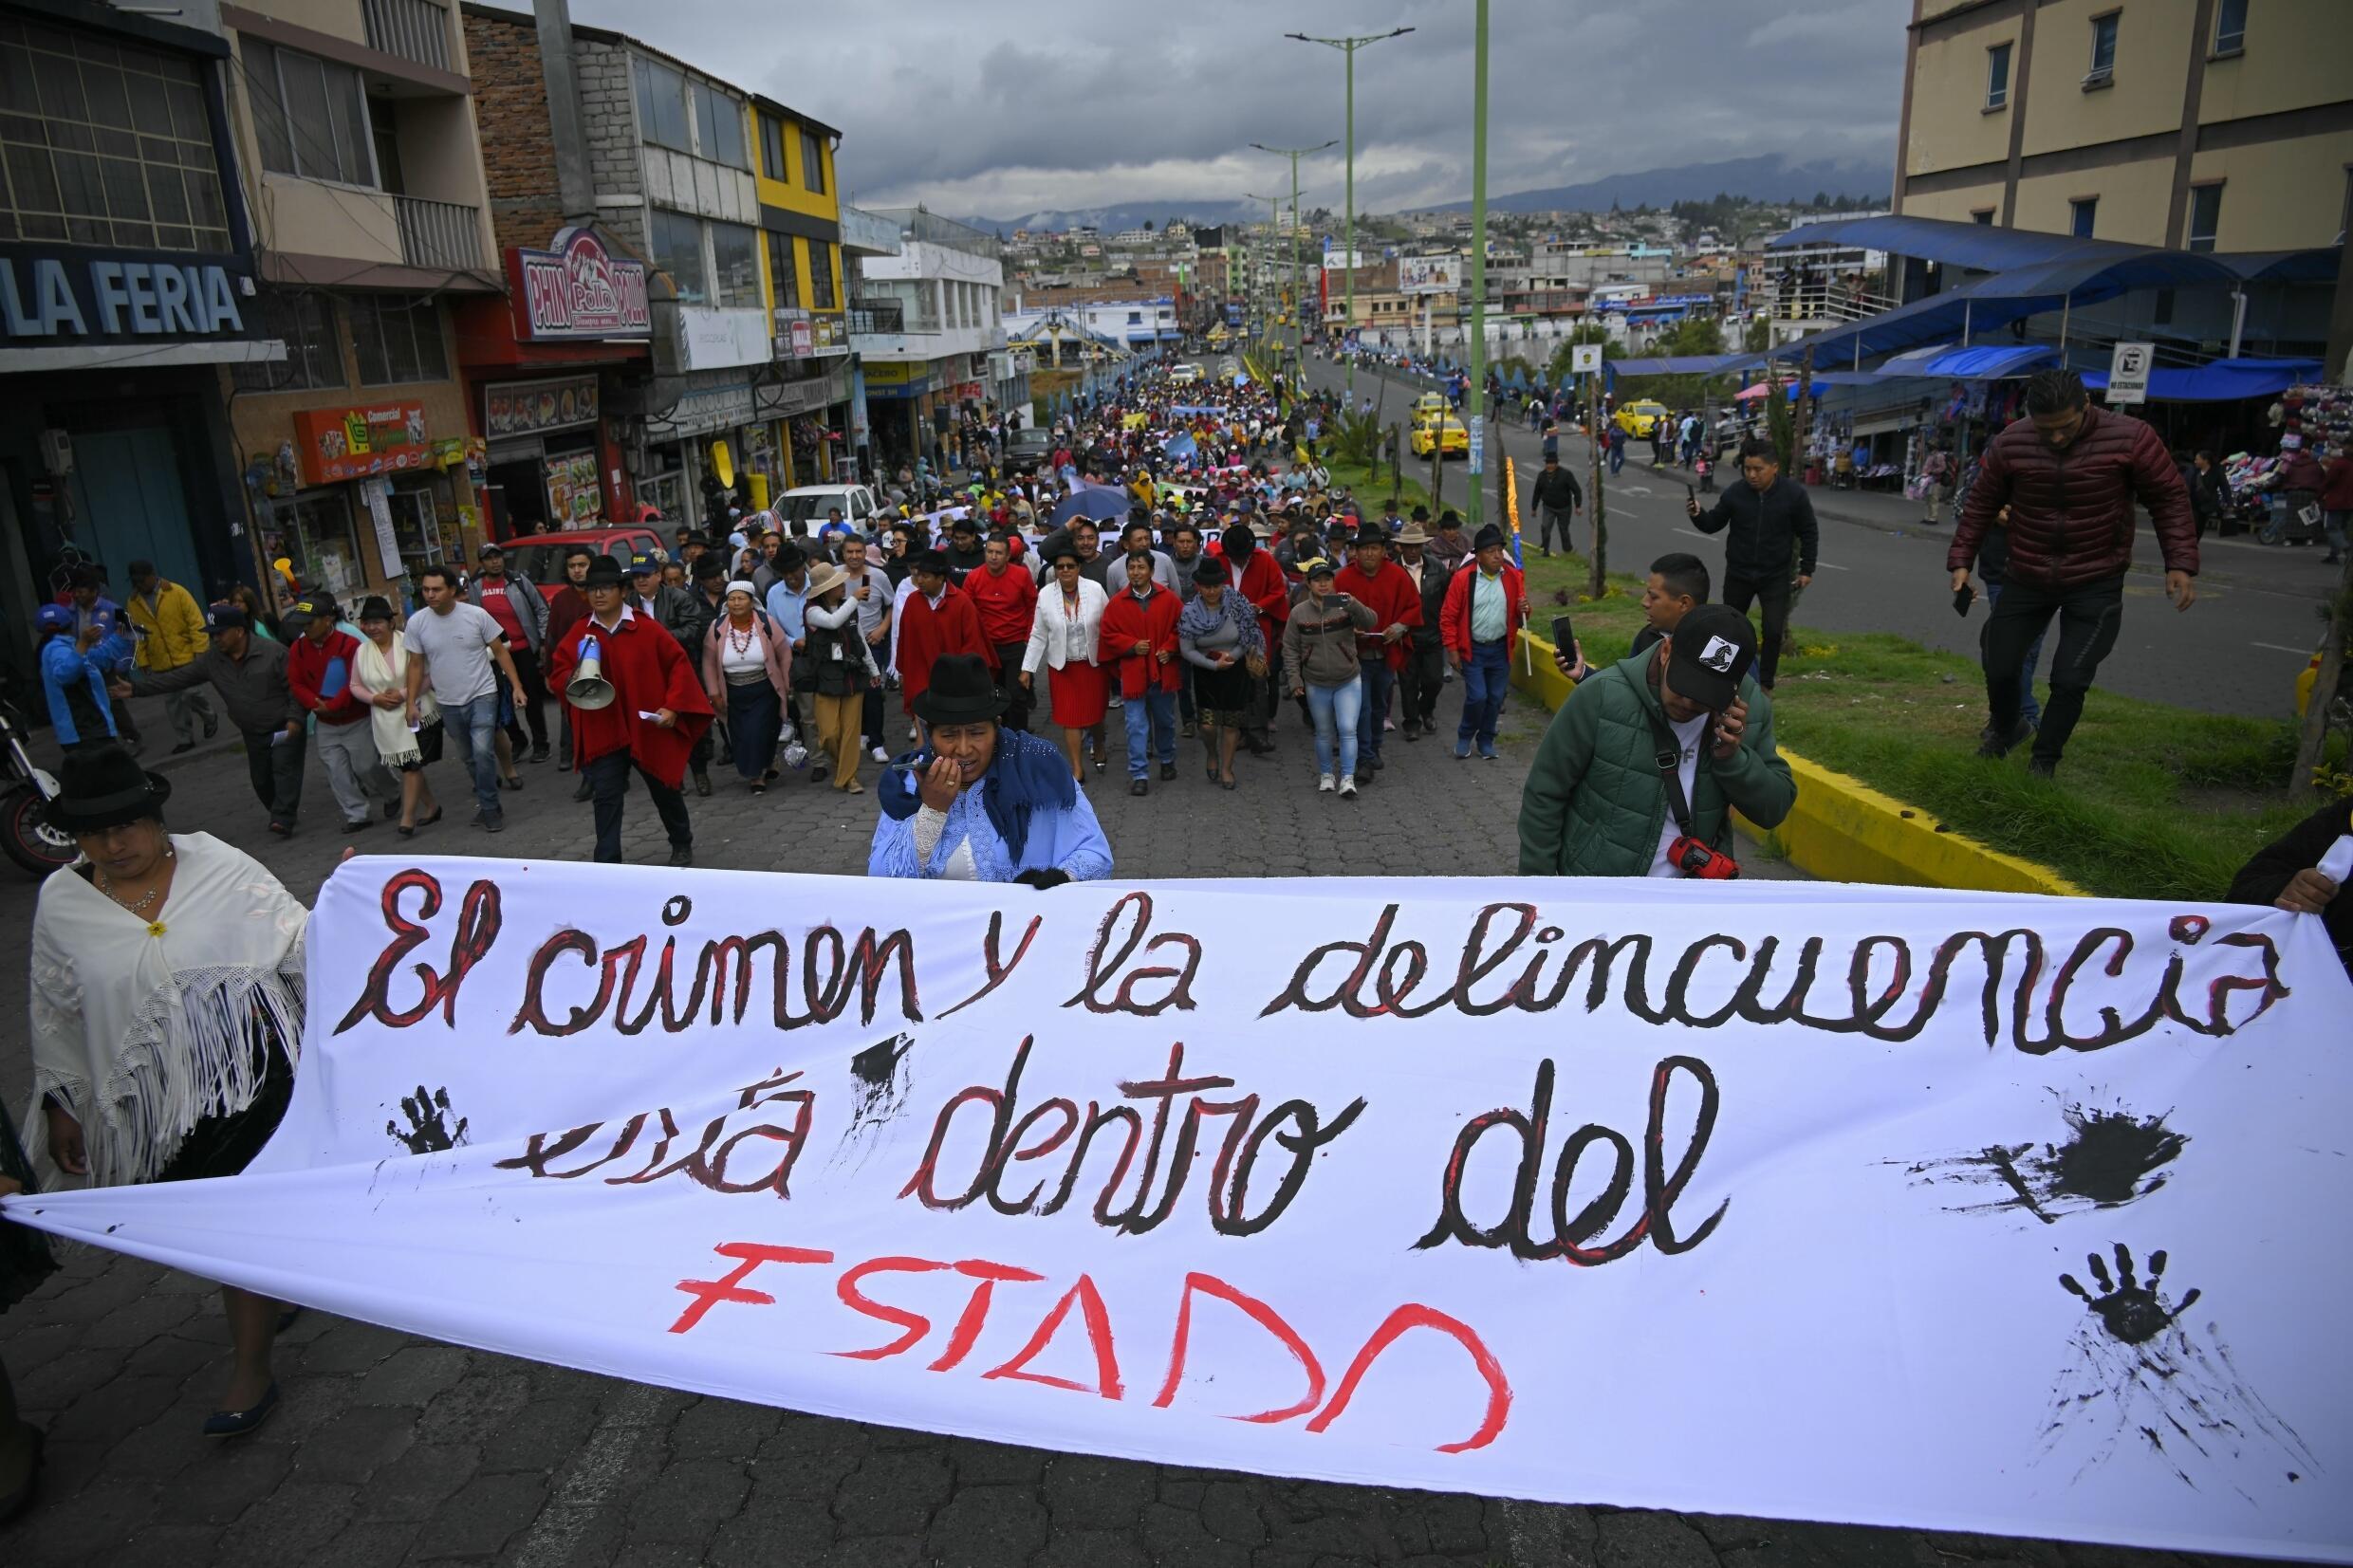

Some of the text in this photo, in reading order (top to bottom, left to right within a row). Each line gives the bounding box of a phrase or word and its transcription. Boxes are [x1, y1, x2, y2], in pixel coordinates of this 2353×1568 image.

[0, 258, 244, 336] LA FERIA
[570, 282, 615, 312] Pollo
[367, 407, 400, 423] Comercial
[333, 869, 2289, 1056] El crimen y la delincuencia
[896, 1034, 1369, 1237] dentro
[1408, 1055, 1732, 1267] del
